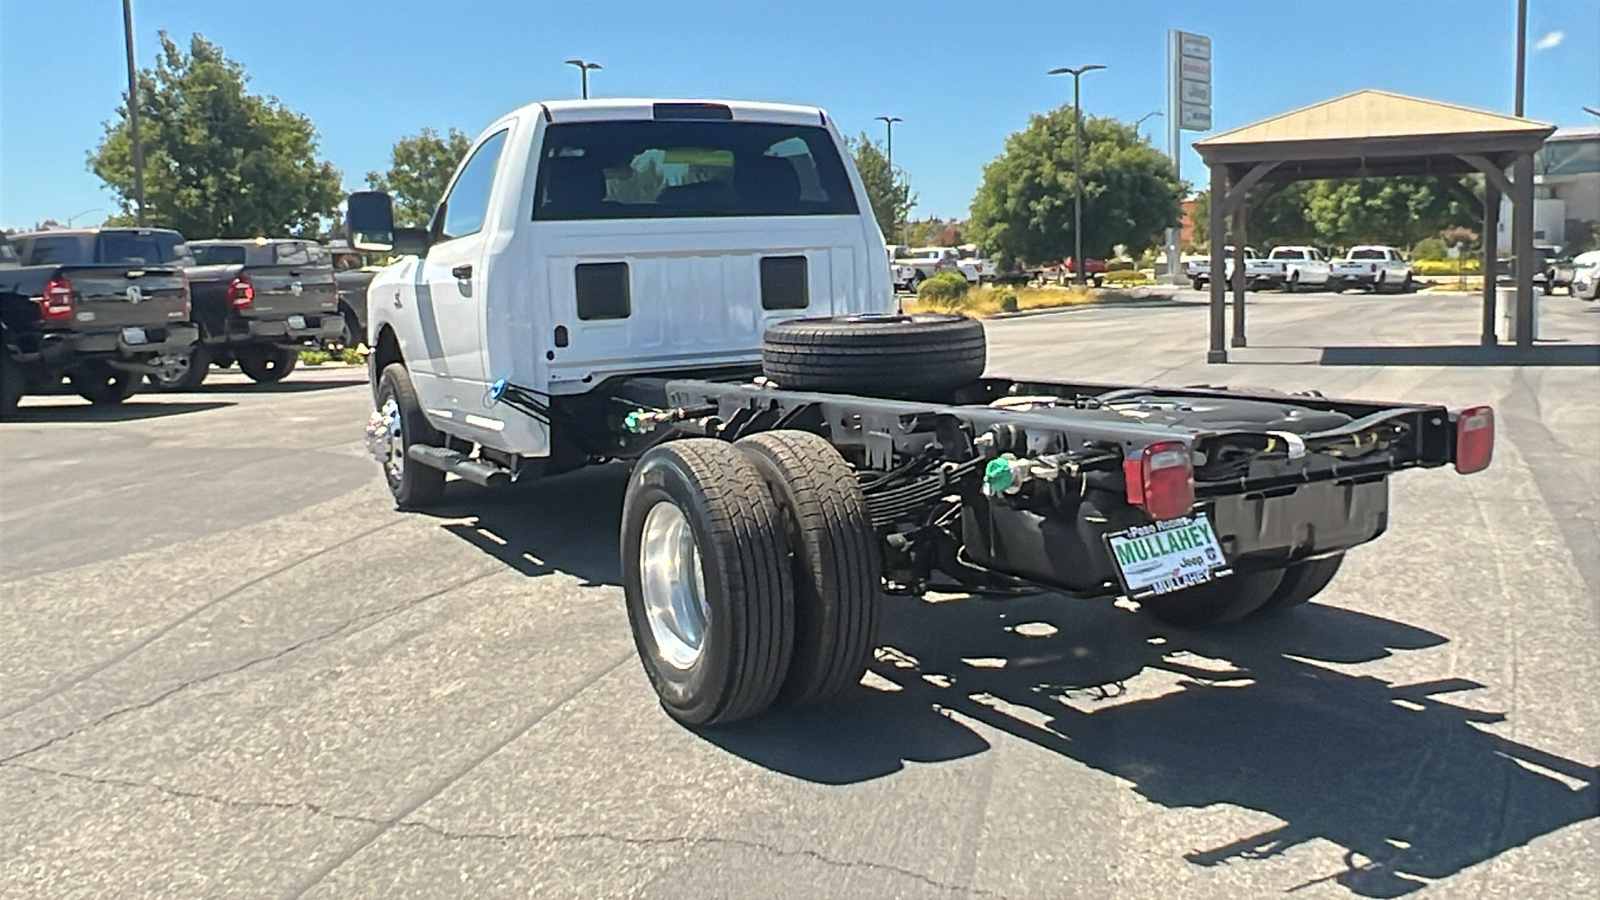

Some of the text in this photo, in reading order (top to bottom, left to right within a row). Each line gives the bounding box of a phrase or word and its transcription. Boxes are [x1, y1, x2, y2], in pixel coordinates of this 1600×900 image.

[1115, 523, 1212, 565] MULLAHEY
[1180, 556, 1204, 567] Jeep
[1152, 570, 1211, 594] MULLAHEY
